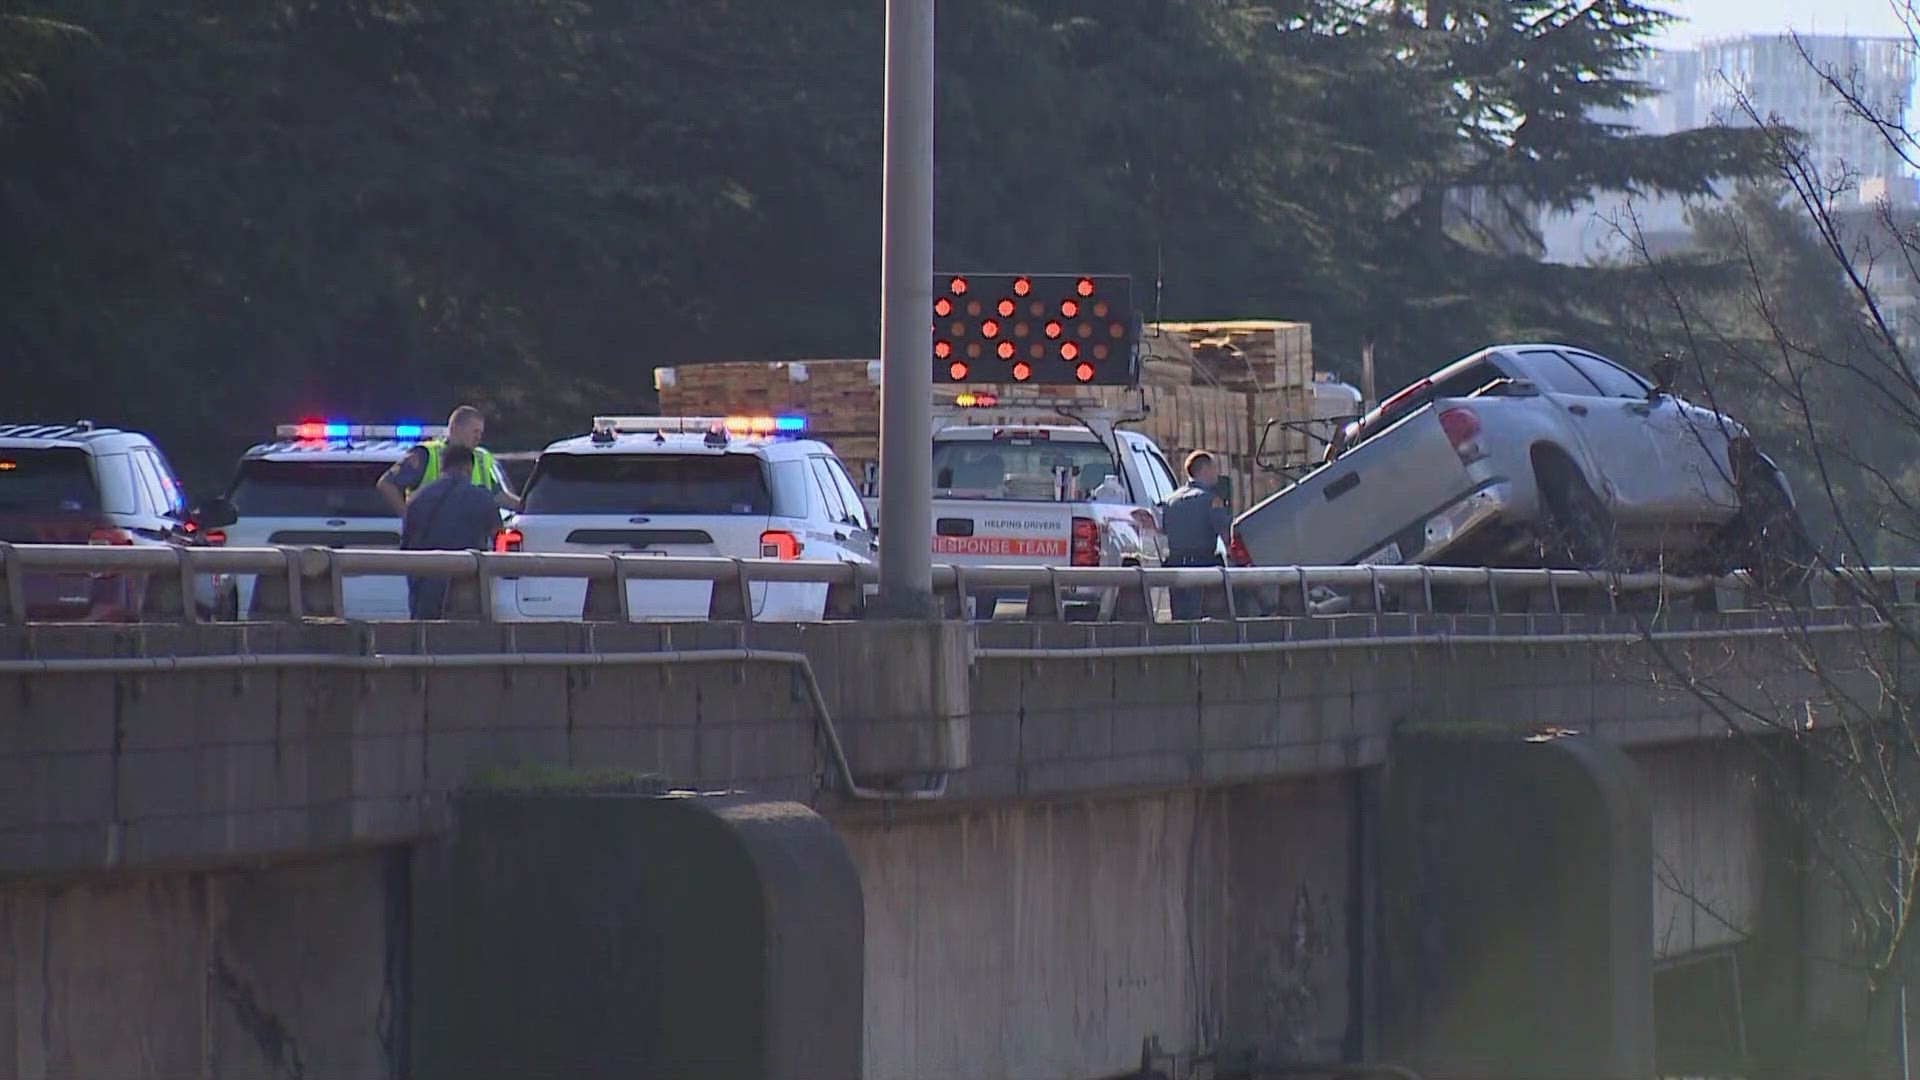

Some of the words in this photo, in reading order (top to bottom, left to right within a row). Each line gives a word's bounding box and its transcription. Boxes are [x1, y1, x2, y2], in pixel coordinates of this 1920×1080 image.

[984, 519, 1022, 529] HELPING
[1023, 520, 1062, 530] DRIVERS
[1017, 540, 1060, 555] TEAM
